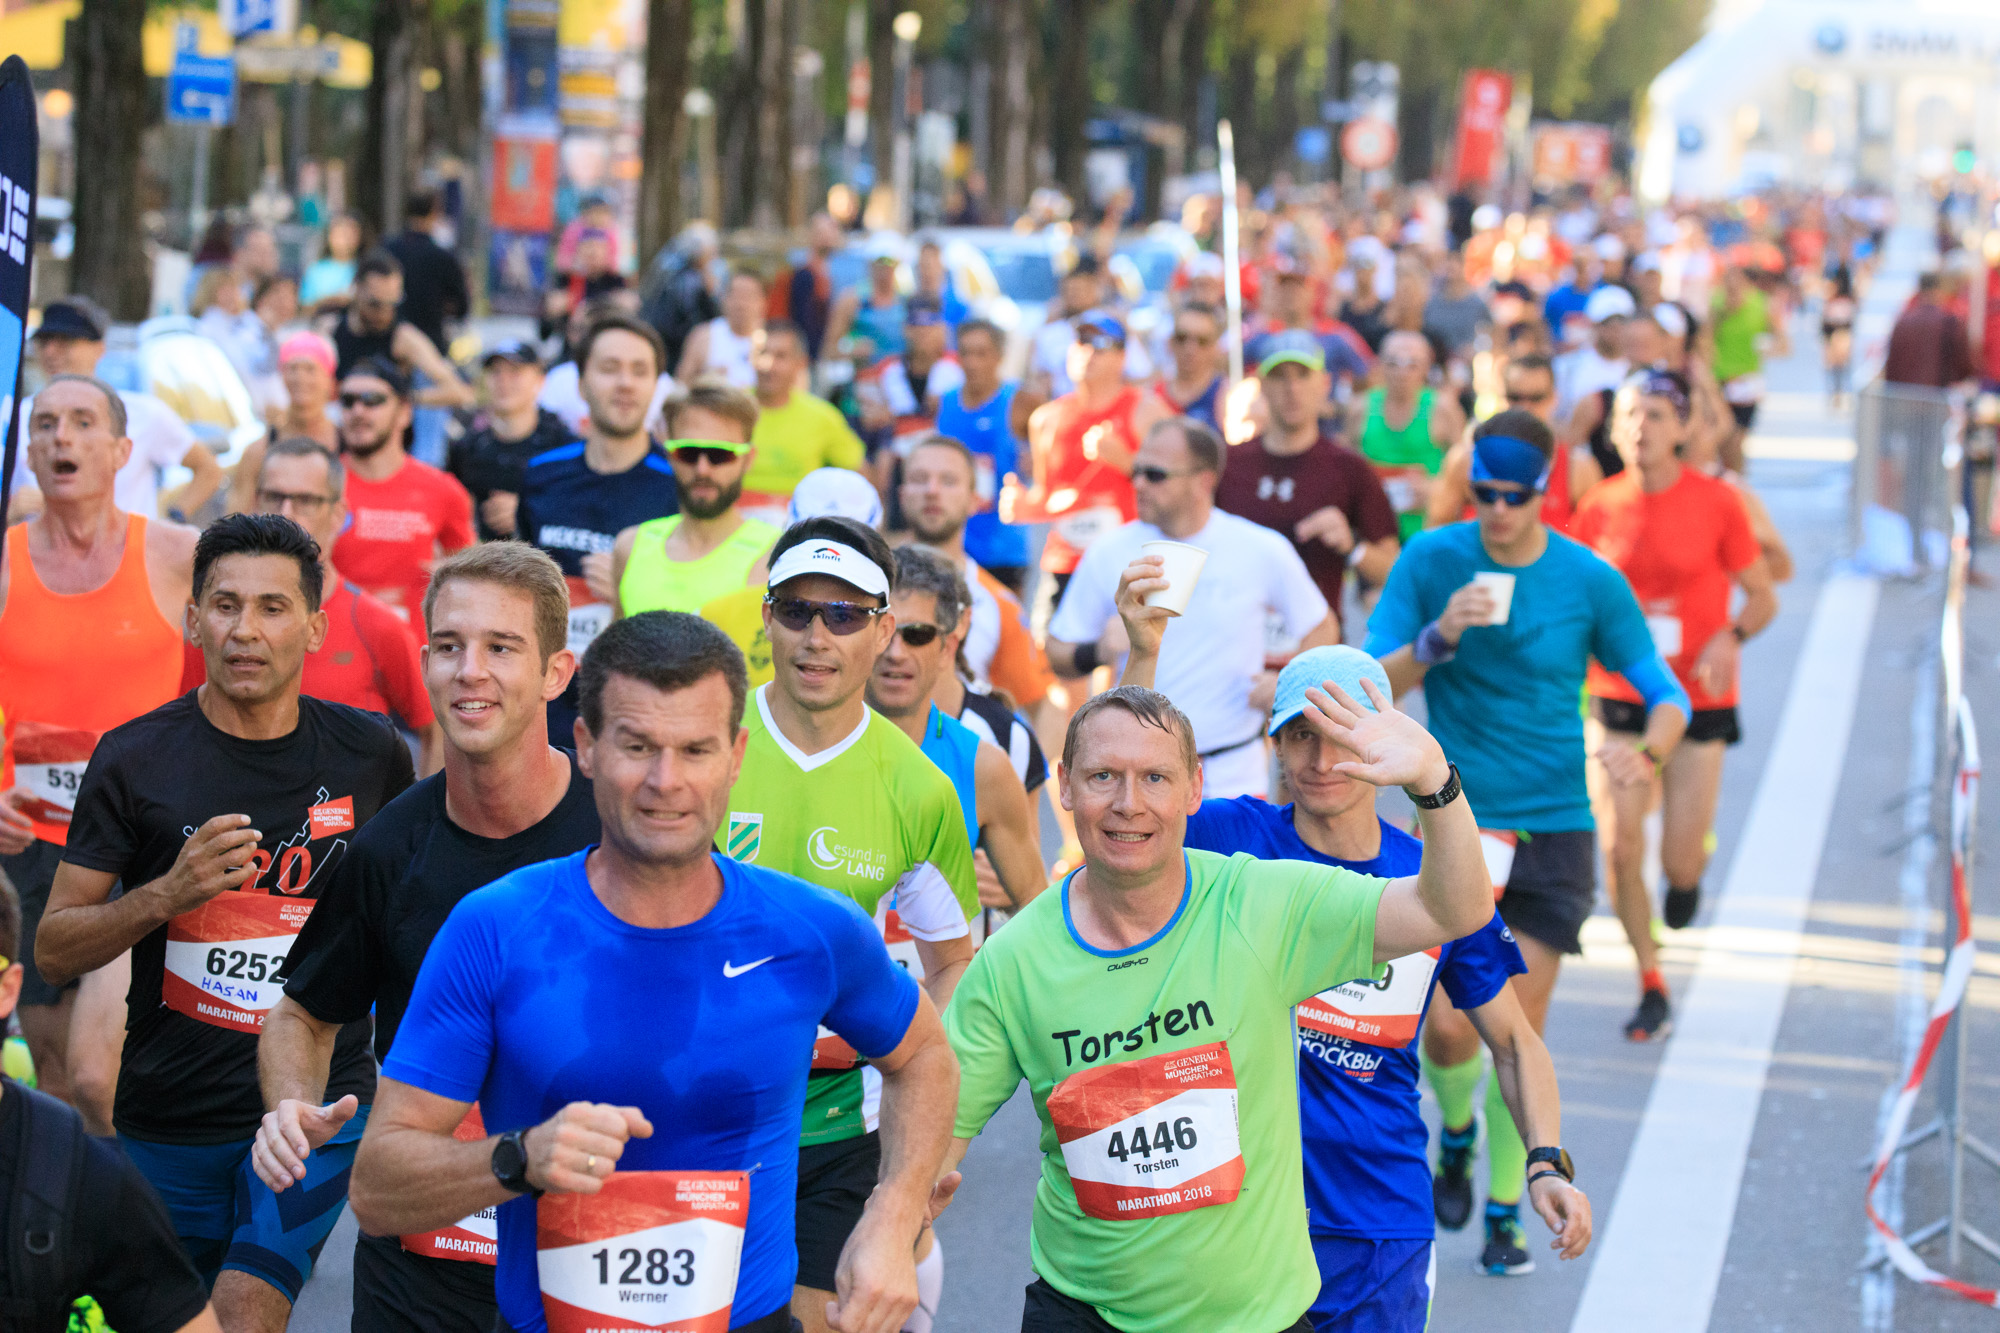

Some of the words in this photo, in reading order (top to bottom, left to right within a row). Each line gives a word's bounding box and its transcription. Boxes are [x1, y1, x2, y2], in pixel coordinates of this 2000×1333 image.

[47, 767, 86, 790] 53
[875, 850, 887, 865] in
[846, 859, 885, 881] LANG
[206, 947, 287, 985] 6252
[201, 976, 258, 1002] HASAN
[197, 1002, 255, 1025] MARATHON
[1297, 1005, 1356, 1030] MARATHON
[1356, 1021, 1381, 1037] 2018
[1051, 1000, 1214, 1067] Torsten
[1176, 1050, 1219, 1068] GENERALI
[1165, 1063, 1209, 1080] MÜNCHEN
[1180, 1068, 1223, 1084] MARATHON
[1107, 1116, 1198, 1163] 4446
[1133, 1157, 1180, 1175] Torsten
[675, 1190, 726, 1202] MÜNCHEN
[691, 1180, 739, 1192] GENERALI
[691, 1201, 740, 1211] MARATHON
[1116, 1190, 1182, 1212] MARATHON
[1183, 1185, 1213, 1202] 2018
[434, 1236, 499, 1256] MARATHON
[591, 1247, 696, 1287] 1283
[618, 1290, 669, 1304] Werner
